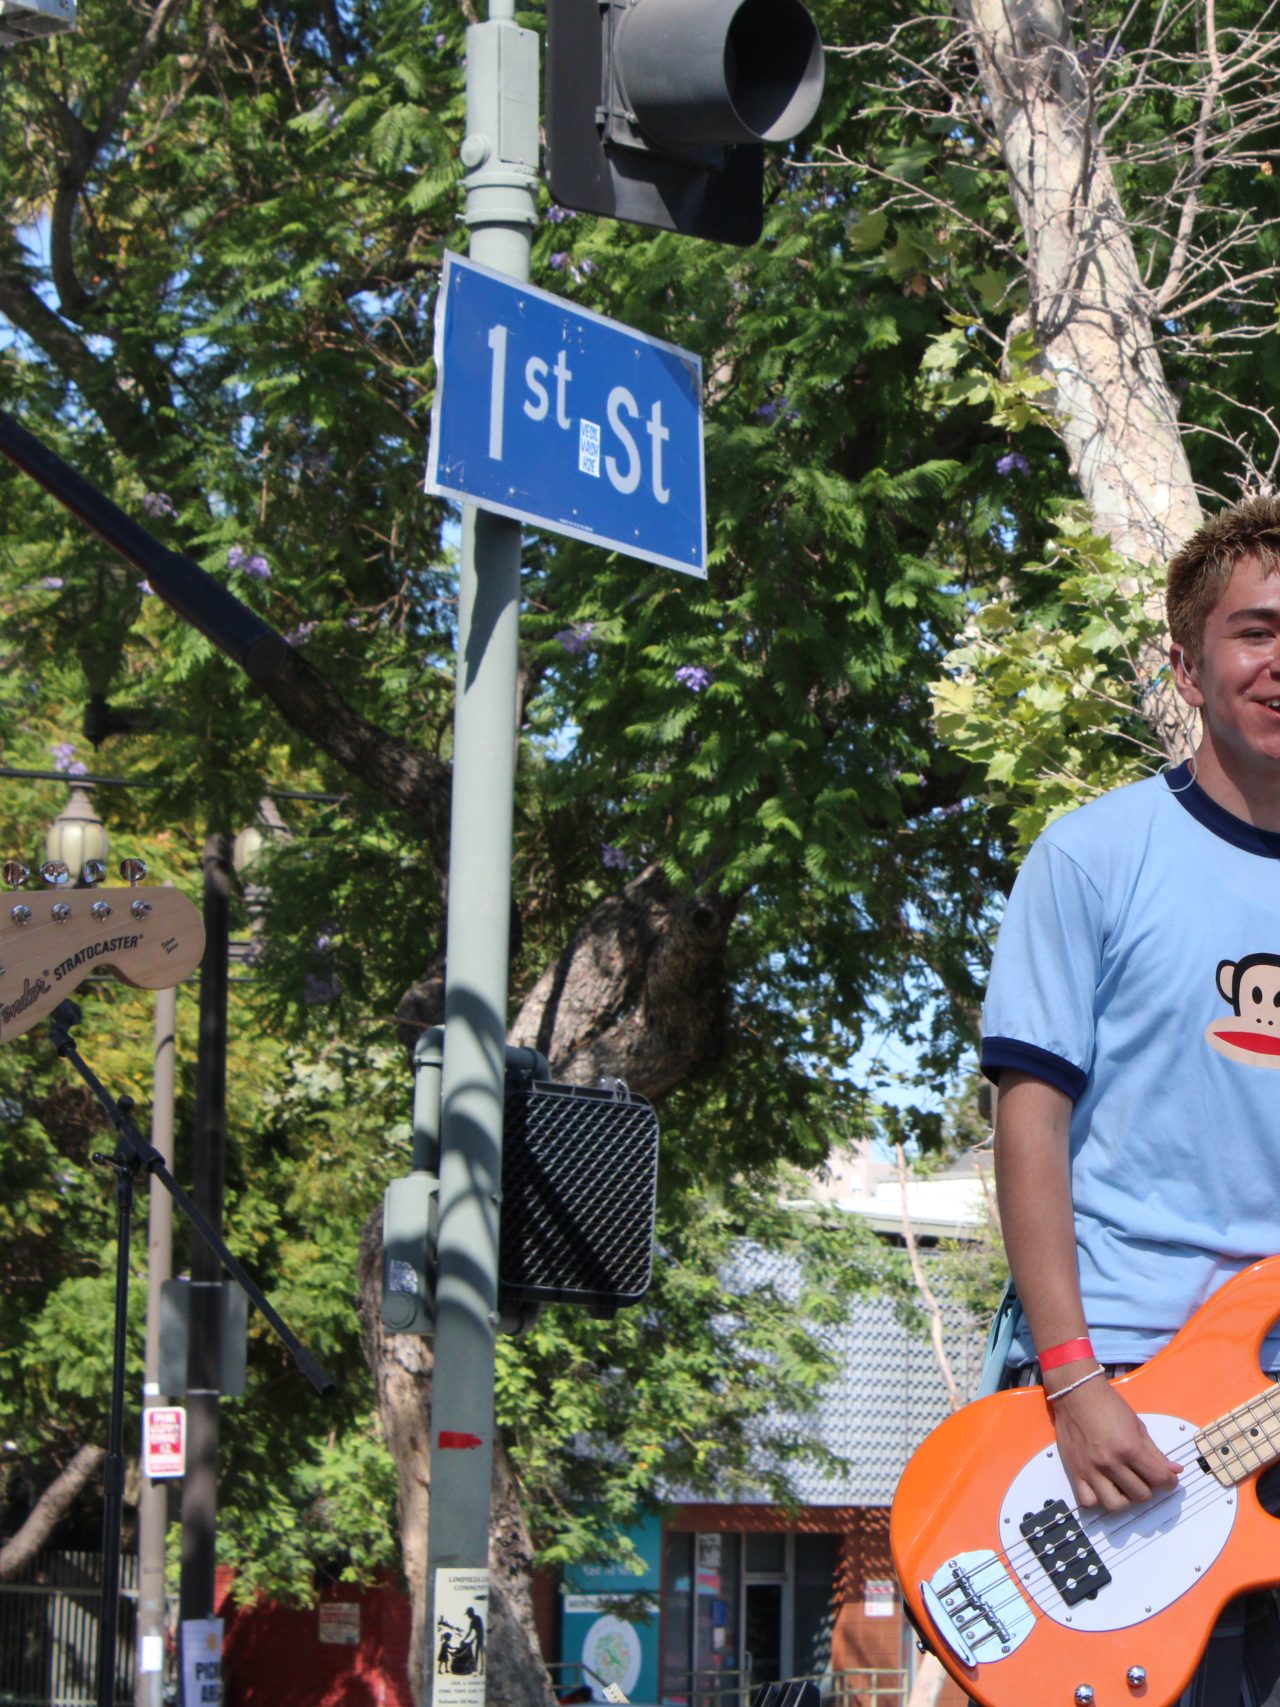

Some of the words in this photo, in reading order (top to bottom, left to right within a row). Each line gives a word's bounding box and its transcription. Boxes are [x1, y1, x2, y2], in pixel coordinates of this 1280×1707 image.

[488, 324, 572, 461] 1st
[605, 386, 670, 504] St
[54, 935, 139, 981] STRATOCASTER
[0, 978, 51, 1024] ender
